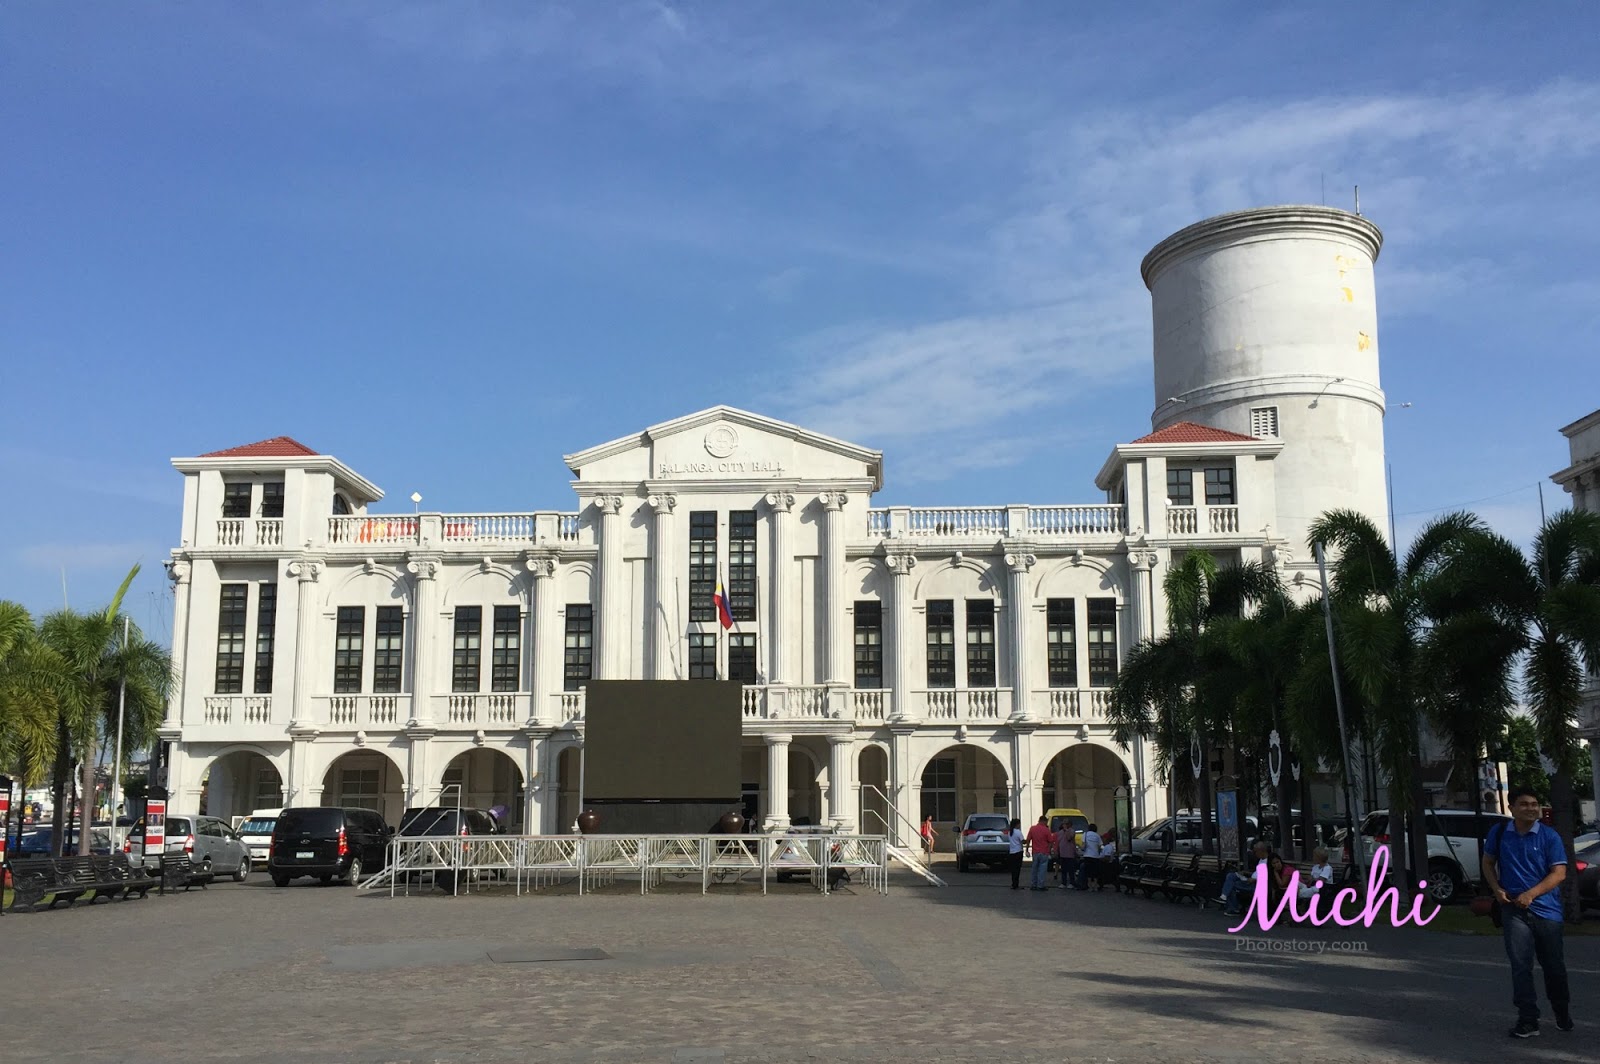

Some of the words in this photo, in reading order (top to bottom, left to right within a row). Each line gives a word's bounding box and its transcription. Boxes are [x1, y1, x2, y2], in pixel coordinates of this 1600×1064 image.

[659, 463, 714, 474] BALANGA
[718, 462, 746, 473] CITY
[752, 461, 786, 472] HALL
